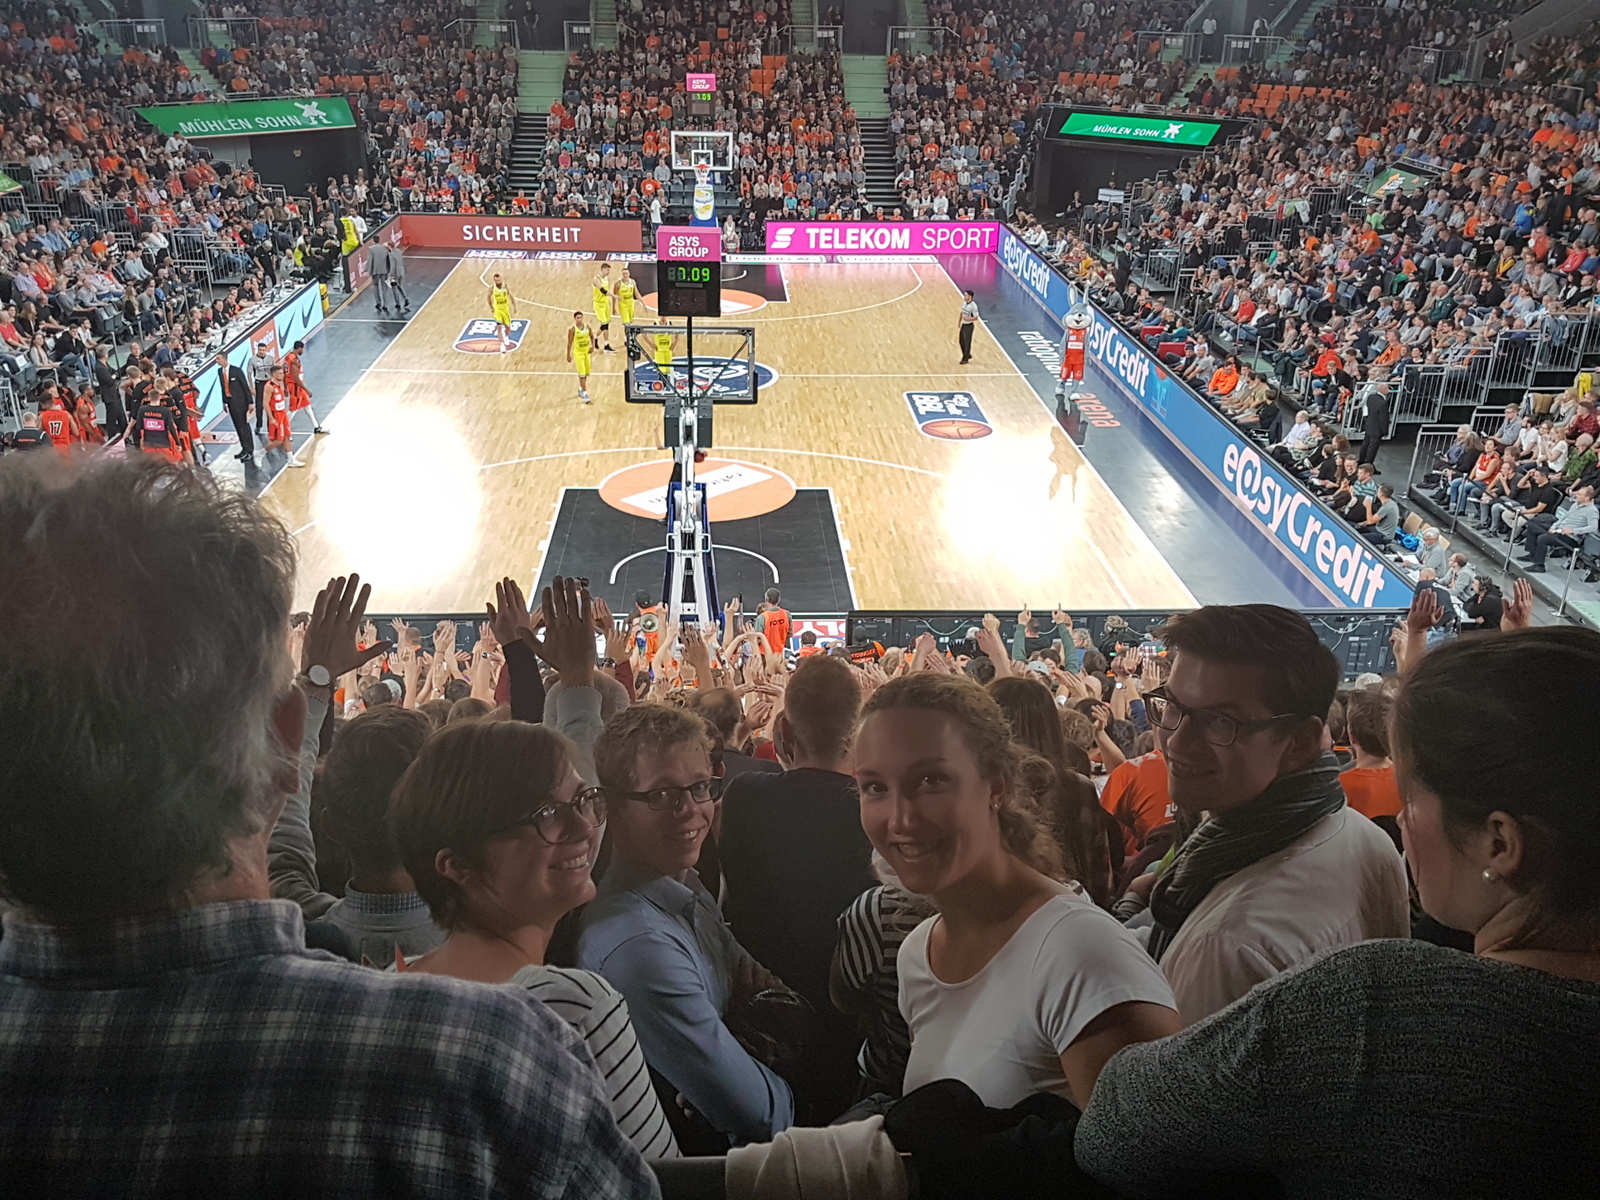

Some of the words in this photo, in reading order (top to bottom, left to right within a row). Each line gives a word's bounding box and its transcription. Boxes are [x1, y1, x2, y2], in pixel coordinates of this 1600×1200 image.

[179, 118, 253, 134] MÜHLEN
[255, 115, 302, 128] SOHN
[1092, 125, 1132, 135] MÜHLEN
[1133, 128, 1159, 137] SOHN
[462, 224, 582, 243] SICHERHEIT
[669, 235, 700, 247] ASYS
[806, 228, 910, 249] TELEKOM
[922, 228, 995, 250] SPORT
[668, 247, 709, 258] GROUP
[1085, 305, 1150, 397] syCredit
[1077, 393, 1122, 428] arena
[49, 421, 63, 435] 17
[770, 618, 785, 627] FOTO
